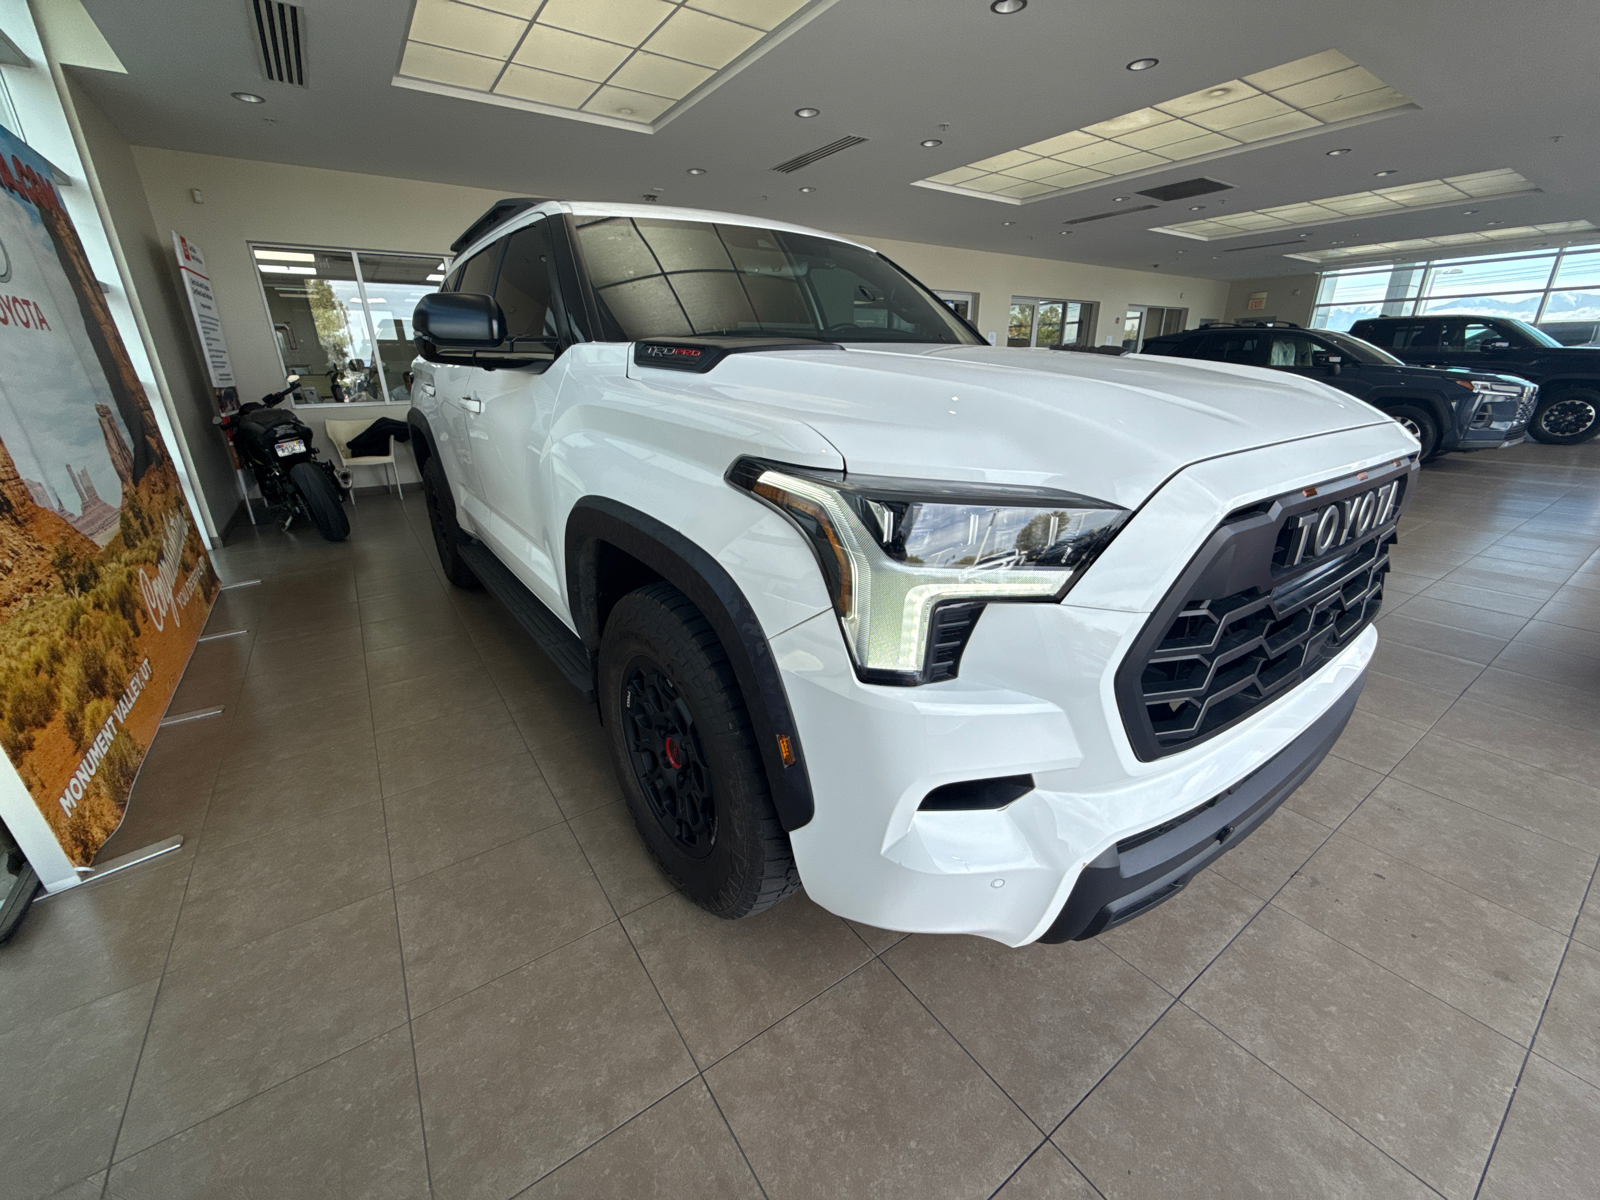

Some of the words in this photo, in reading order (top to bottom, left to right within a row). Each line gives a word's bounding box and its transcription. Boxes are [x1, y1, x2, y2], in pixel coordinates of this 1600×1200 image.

[0, 294, 52, 331] YOTA
[645, 345, 675, 357] TRD
[674, 348, 701, 357] PRO
[1293, 480, 1399, 566] TOYOTA
[59, 715, 118, 818] MONUMENT
[113, 672, 146, 724] VALLEY,
[139, 657, 153, 681] UT
